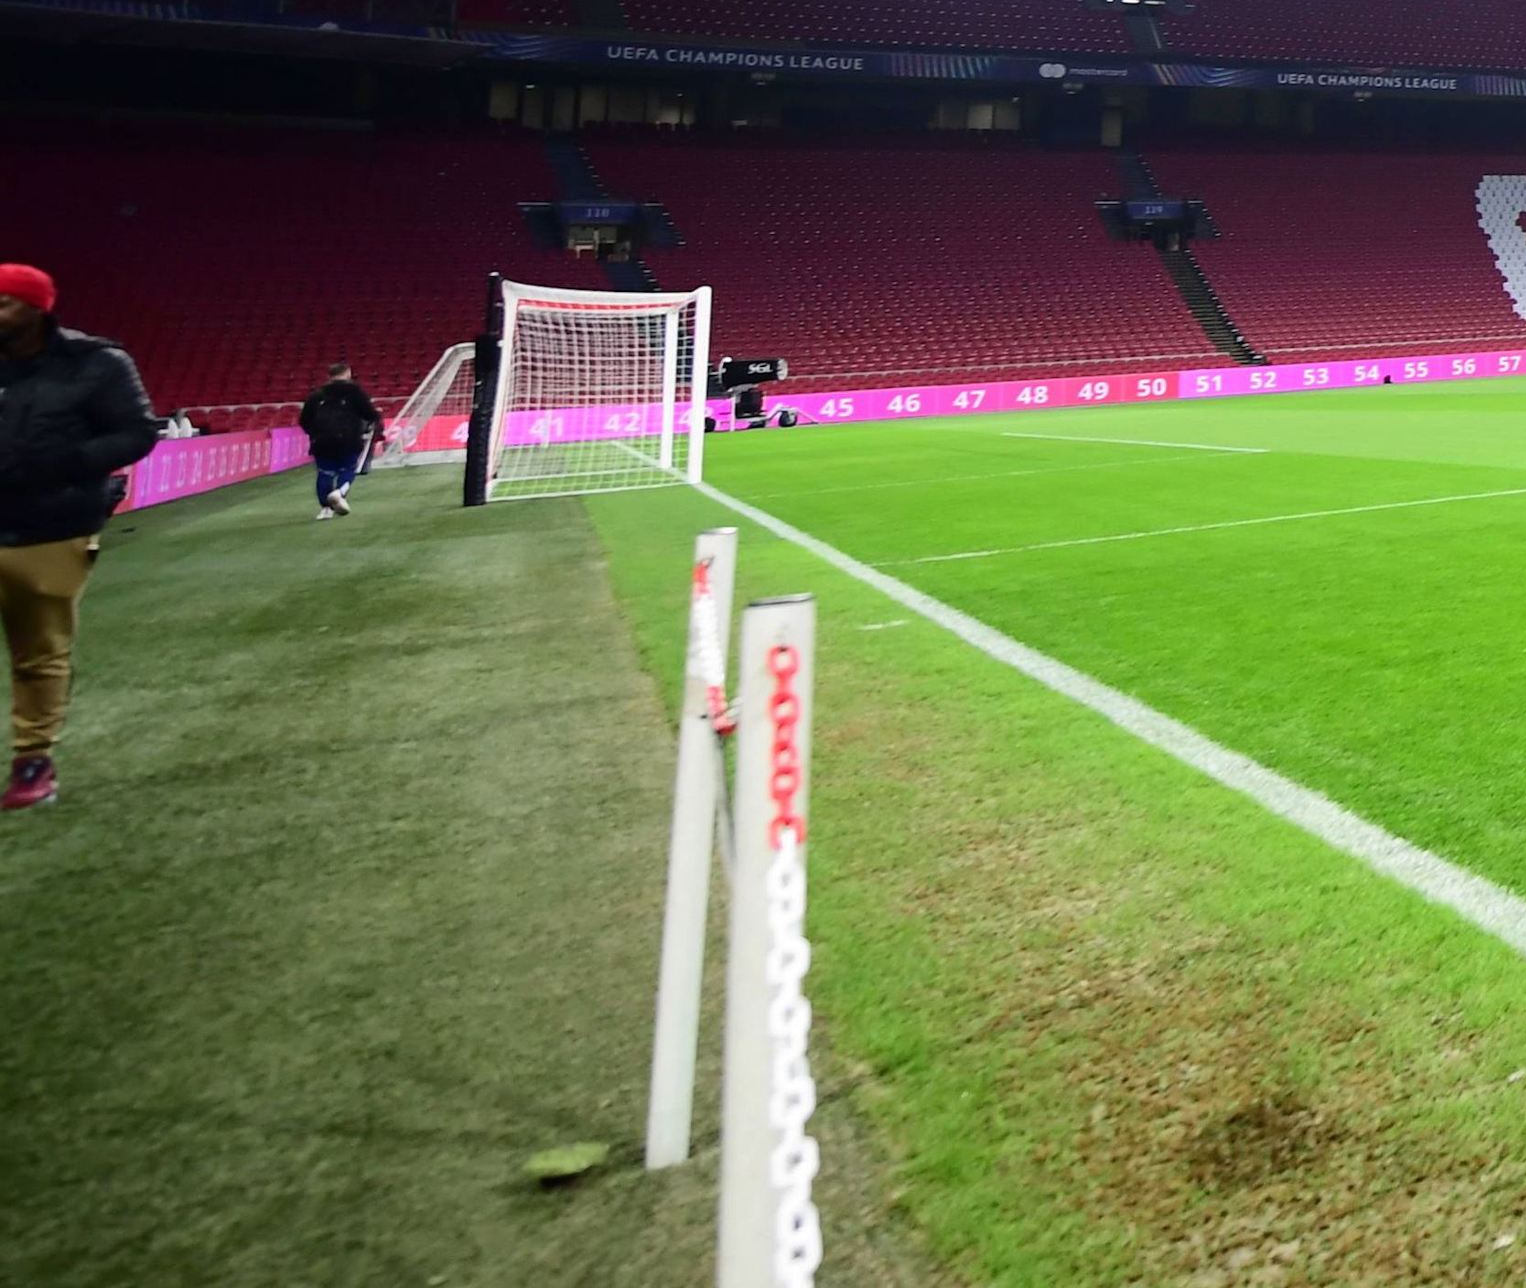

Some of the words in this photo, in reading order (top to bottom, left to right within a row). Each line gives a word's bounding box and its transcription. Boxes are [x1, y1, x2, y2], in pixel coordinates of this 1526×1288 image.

[607, 46, 658, 63] UEFA
[666, 48, 783, 68] CHAMPIONS
[790, 54, 864, 70] LEAGUE
[1277, 73, 1313, 86] UEFA
[1317, 74, 1400, 89] CHAMPIONS
[1404, 77, 1457, 90] LEAGUE
[747, 362, 774, 374] SGL
[603, 412, 641, 432] 42
[820, 398, 853, 417] 45
[888, 394, 920, 412] 46
[954, 390, 985, 408] 47
[1017, 386, 1048, 404] 48
[1079, 382, 1109, 400] 49
[1138, 378, 1166, 396] 50
[1197, 376, 1221, 392] 51
[1251, 372, 1276, 389] 52
[1304, 368, 1328, 385] 53
[1355, 365, 1379, 381] 54
[1405, 362, 1428, 378] 55
[1453, 359, 1475, 375] 56
[1499, 356, 1521, 372] 57
